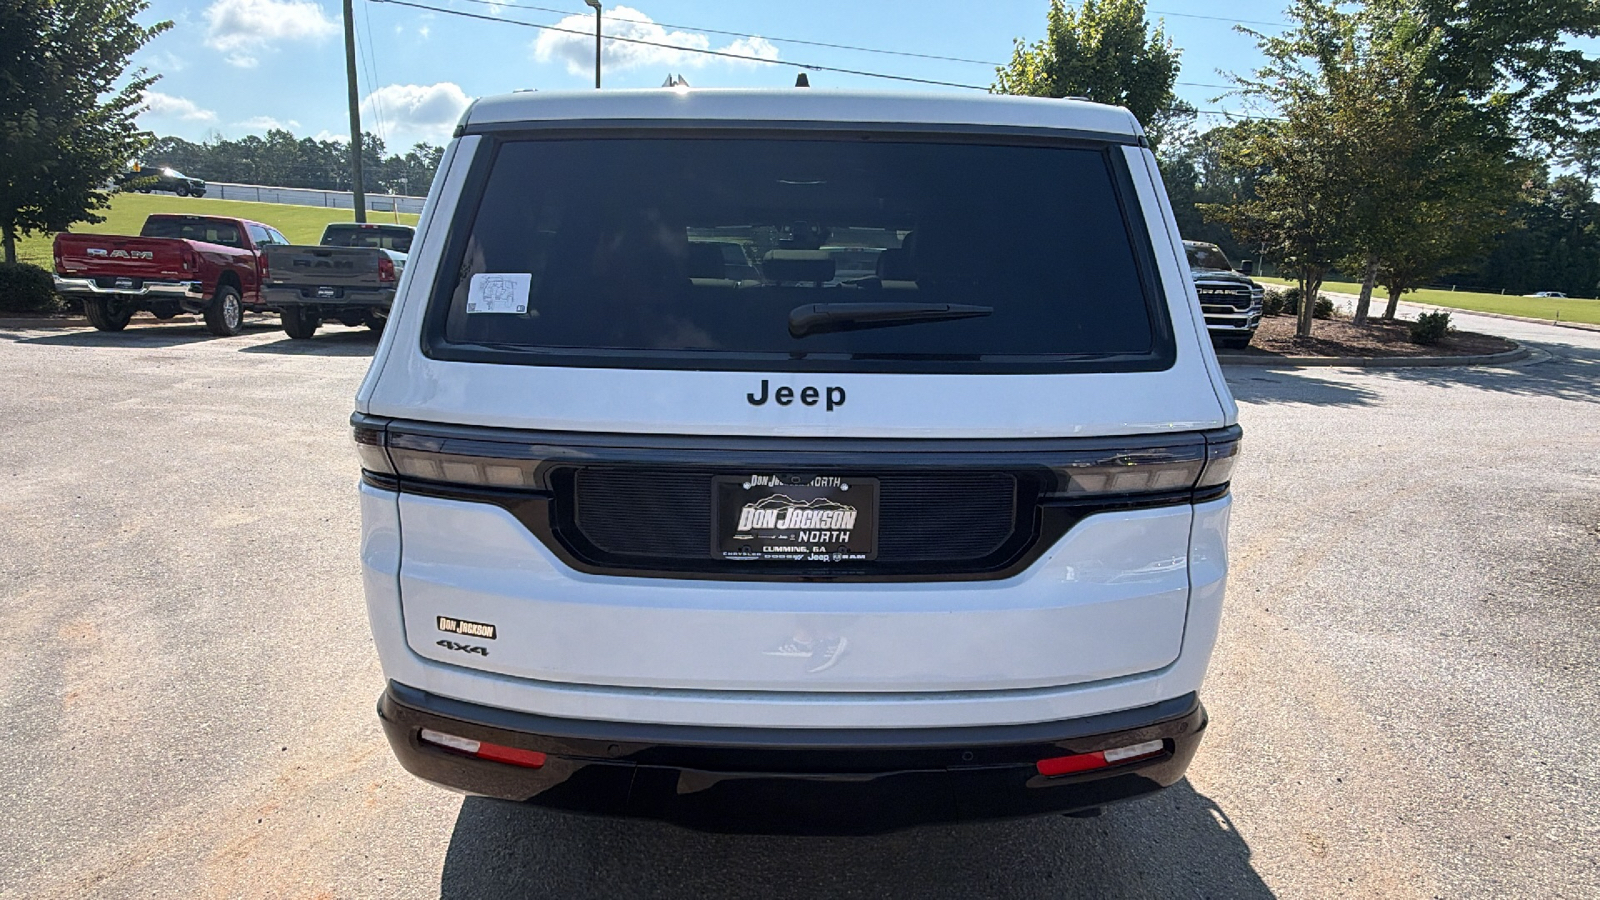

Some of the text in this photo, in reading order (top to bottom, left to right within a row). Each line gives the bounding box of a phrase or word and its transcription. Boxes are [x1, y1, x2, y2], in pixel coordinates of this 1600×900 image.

[86, 248, 153, 260] RAM
[292, 259, 354, 269] RAM
[746, 379, 846, 412] Jeep
[737, 507, 857, 531] DON JACKSON
[798, 531, 850, 543] NORTH
[807, 553, 830, 562] Jeep
[440, 617, 494, 638] DON JACKSON
